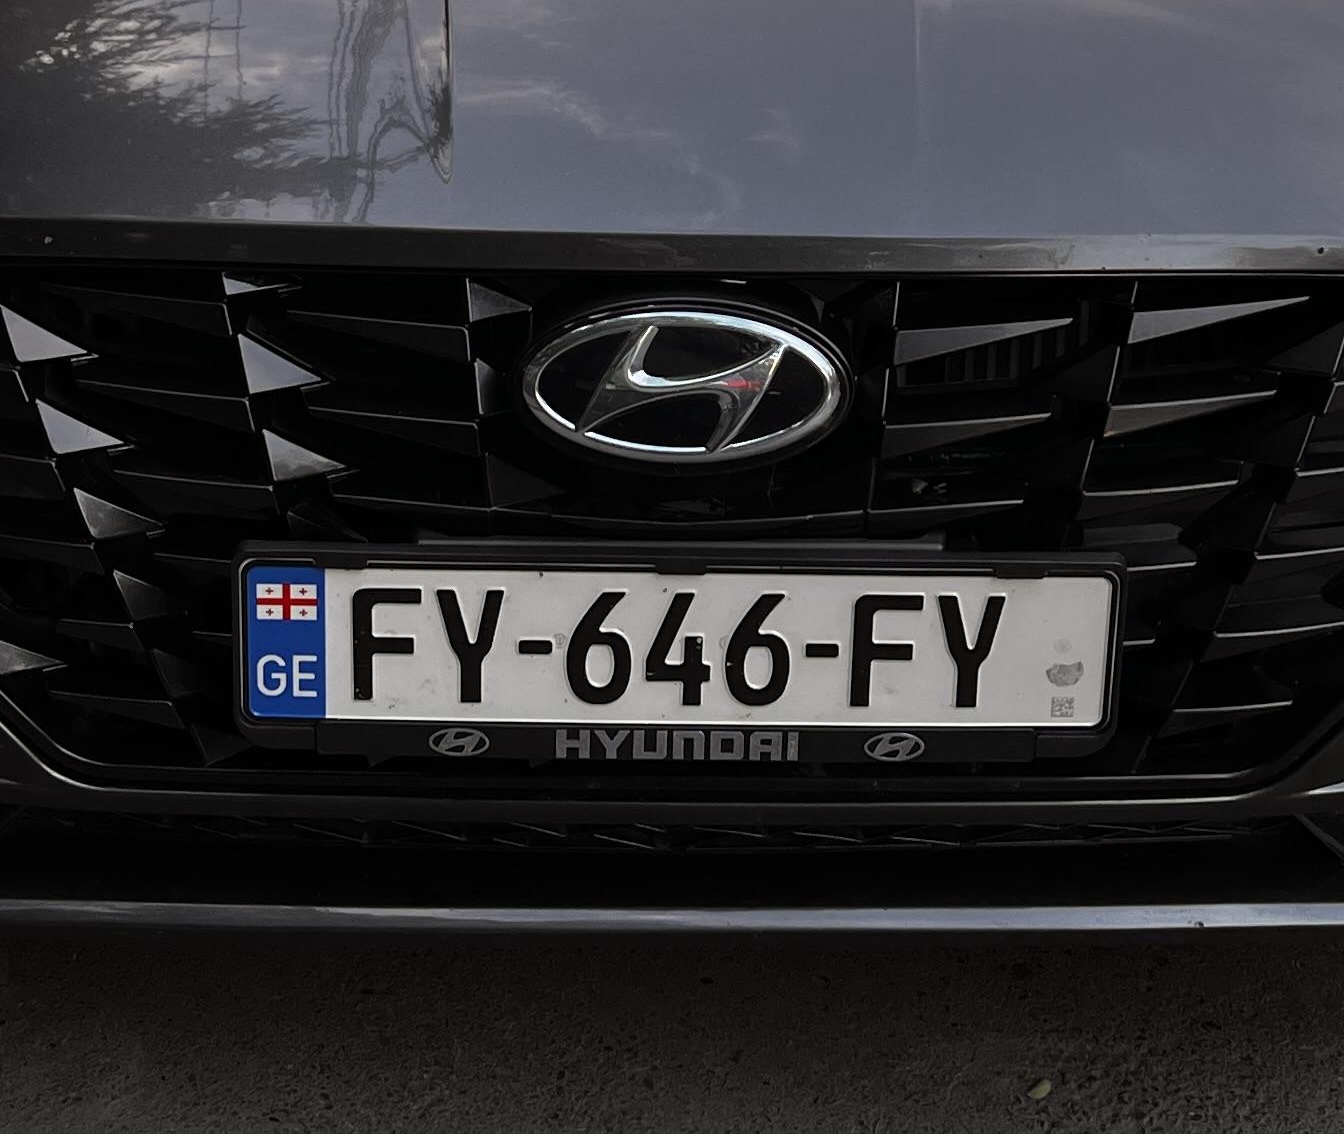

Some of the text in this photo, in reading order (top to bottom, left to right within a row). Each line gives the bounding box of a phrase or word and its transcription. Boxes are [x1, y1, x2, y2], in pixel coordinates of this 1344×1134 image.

[353, 588, 1006, 708] FY-646-FY
[256, 654, 318, 698] GE
[556, 729, 800, 762] HYUNDAI
